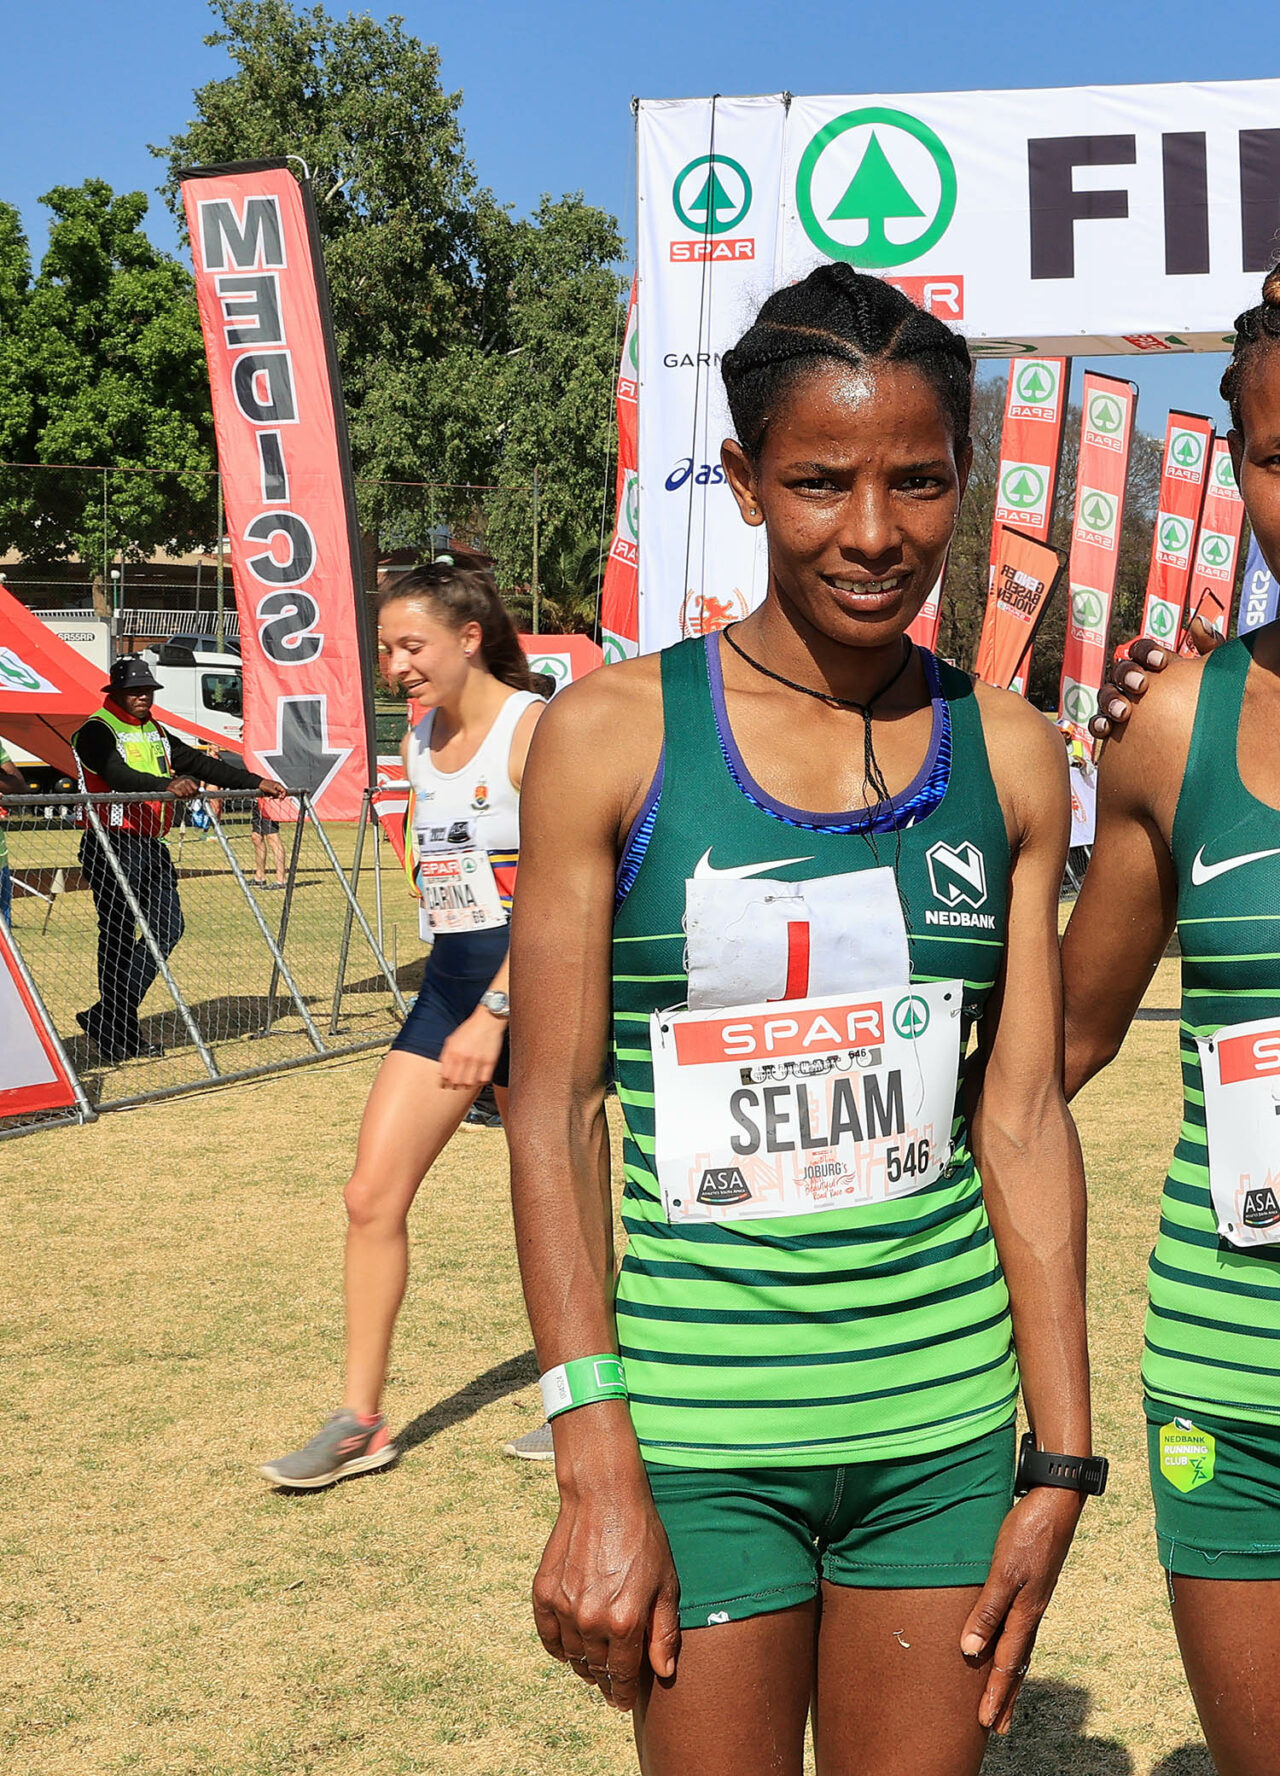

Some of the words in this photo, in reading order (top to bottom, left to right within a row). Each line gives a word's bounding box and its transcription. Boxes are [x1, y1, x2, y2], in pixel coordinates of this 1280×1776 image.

[671, 241, 754, 261] SPAR
[925, 910, 996, 930] NEDBANK
[722, 1010, 881, 1055] SPAR
[730, 1069, 906, 1156] SELAM
[886, 1139, 930, 1182] 546
[703, 1171, 744, 1190] ASA
[1245, 1192, 1277, 1213] ASA
[1164, 1435, 1205, 1444] NEDBANK
[1164, 1445, 1208, 1454] RUNNING
[1164, 1456, 1188, 1465] CLUB
